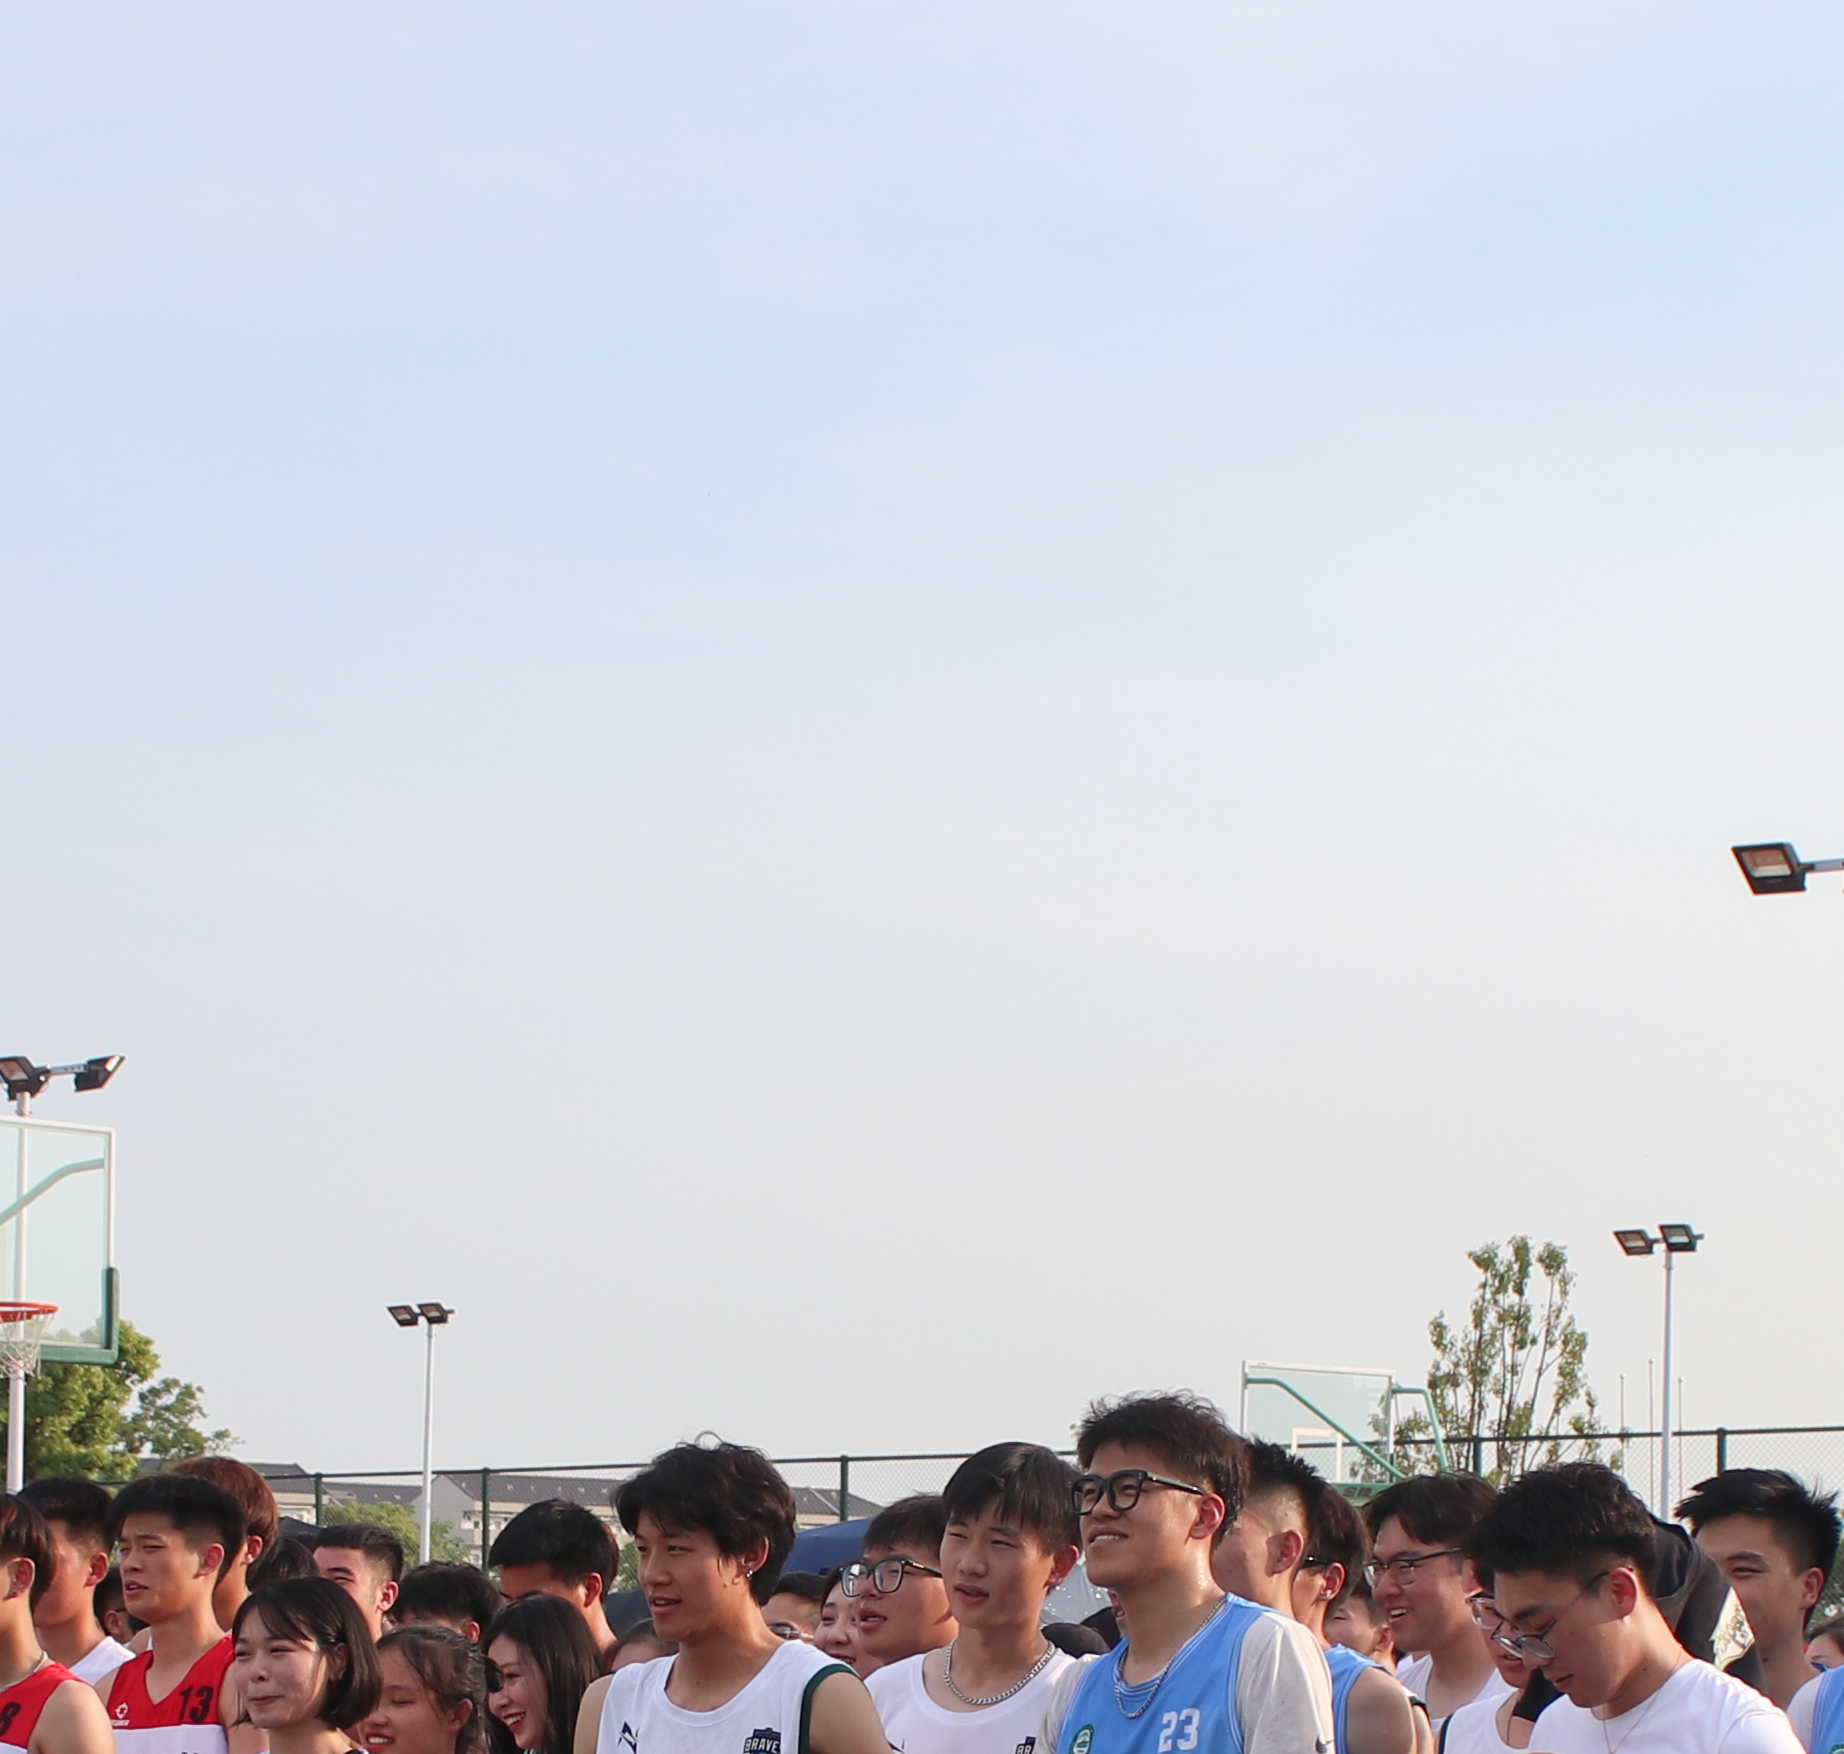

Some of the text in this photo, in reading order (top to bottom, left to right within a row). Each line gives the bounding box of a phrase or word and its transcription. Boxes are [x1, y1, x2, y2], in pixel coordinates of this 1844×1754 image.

[179, 1685, 214, 1723] 13
[744, 1737, 780, 1754] BRAVE
[1158, 1708, 1200, 1752] 23
